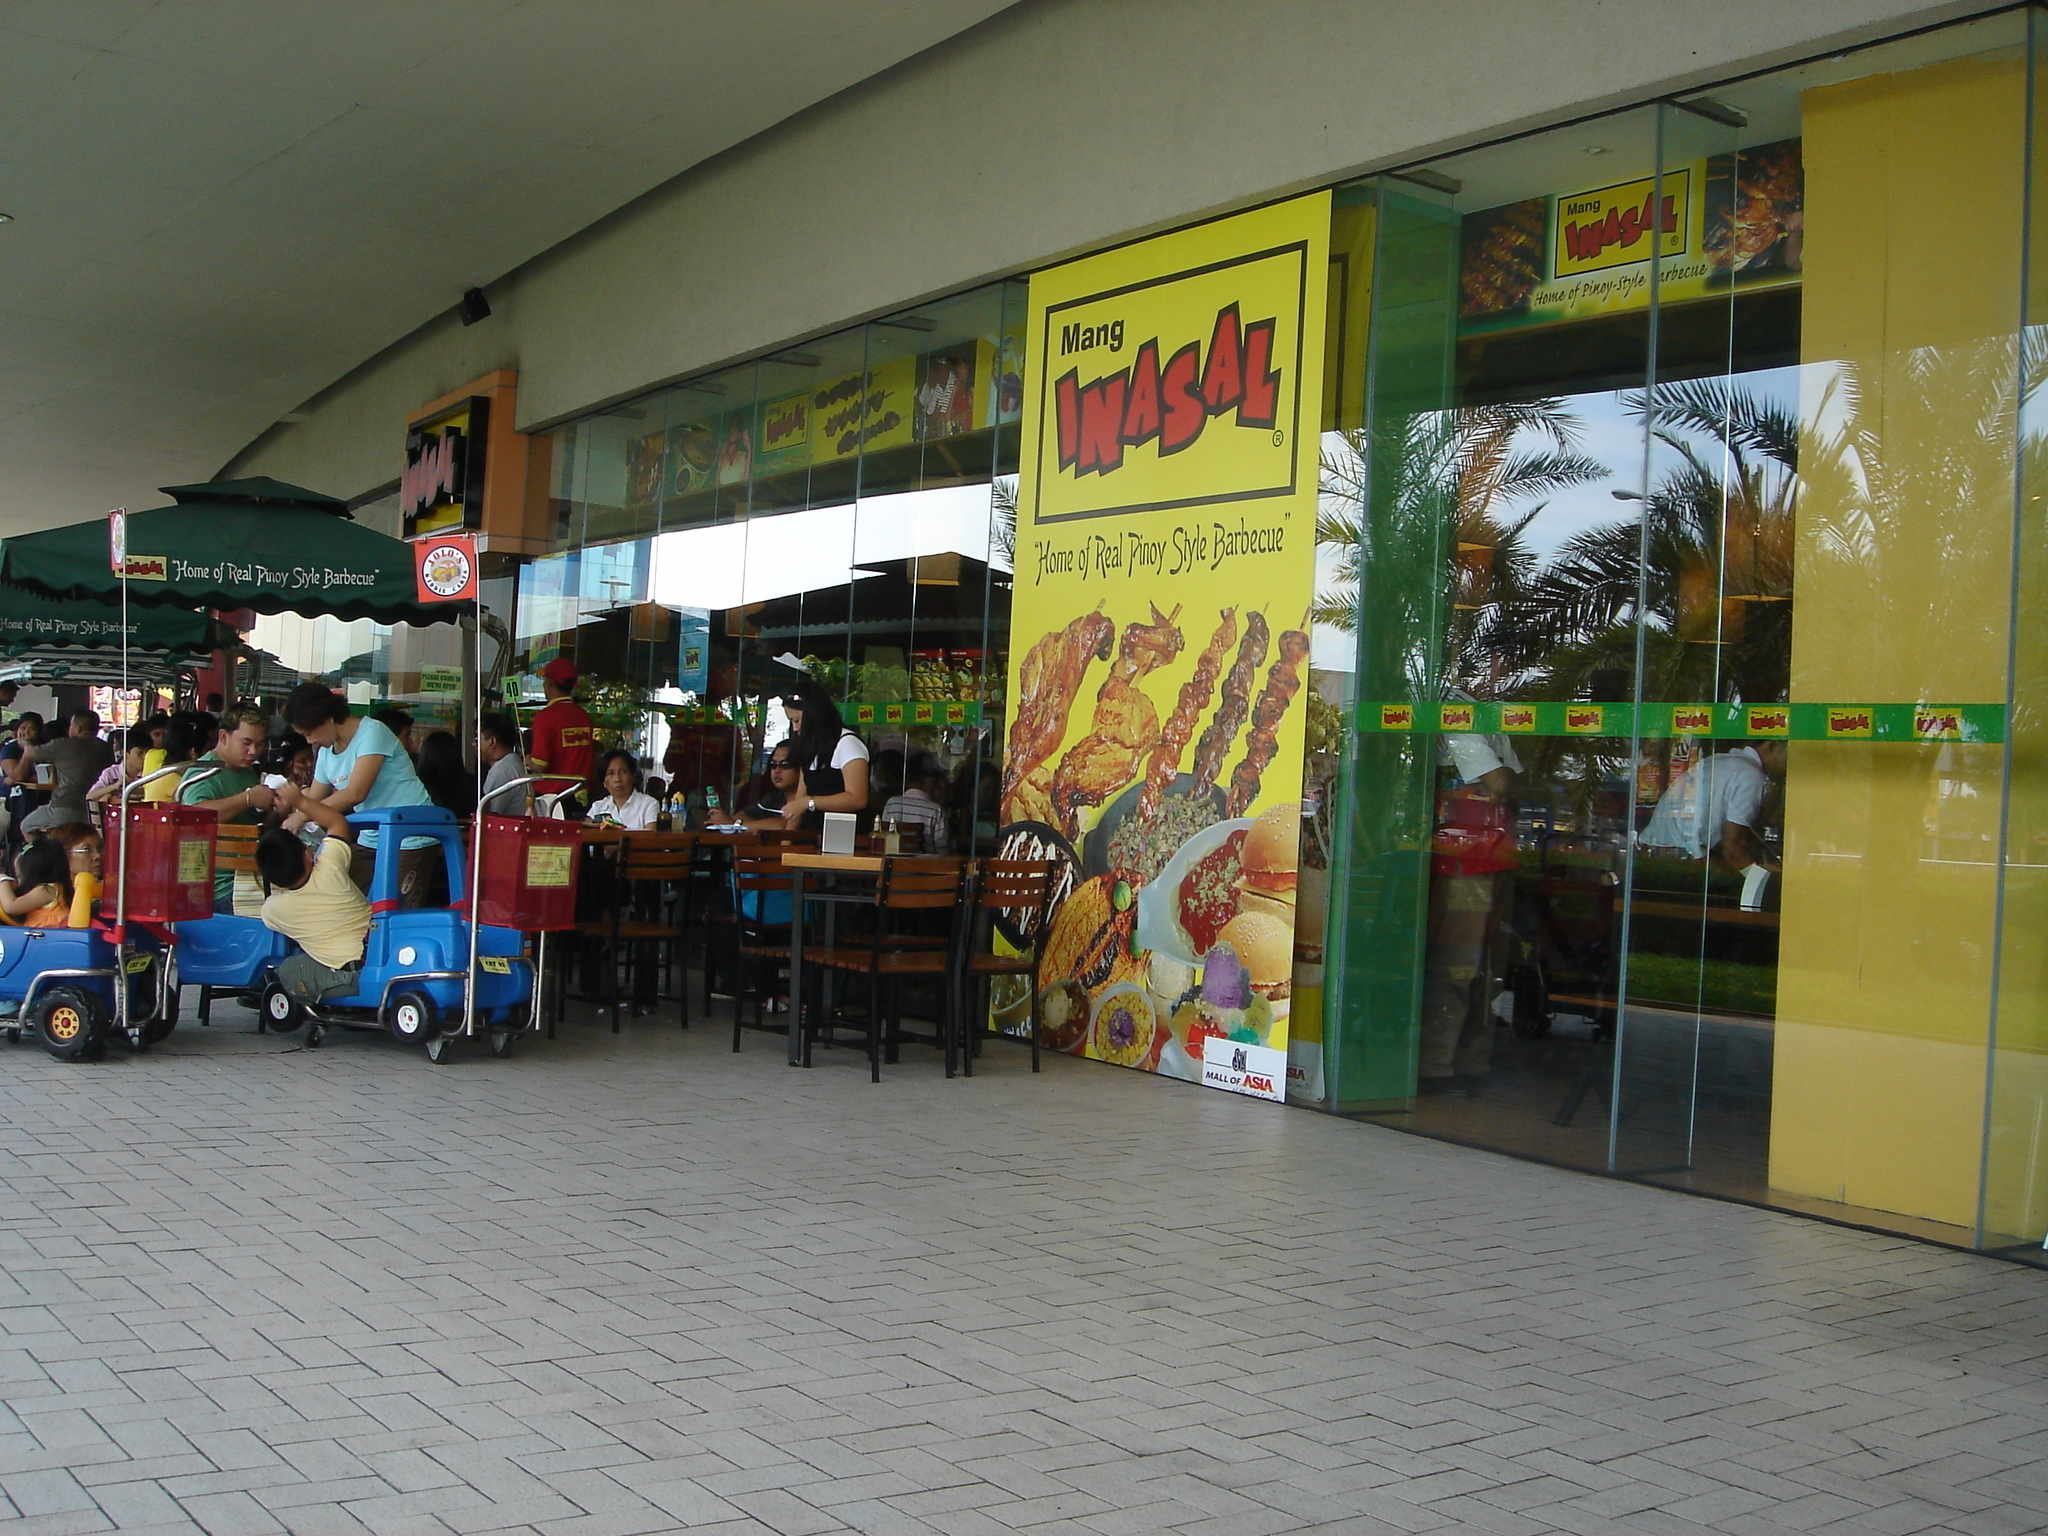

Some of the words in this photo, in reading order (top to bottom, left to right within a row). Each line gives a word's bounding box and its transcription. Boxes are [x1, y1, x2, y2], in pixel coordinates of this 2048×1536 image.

[1567, 200, 1601, 217] Mang
[1534, 289, 1567, 308] Home
[1568, 282, 1581, 310] of
[1655, 262, 1709, 284] arbecue
[1060, 317, 1125, 357] Mang
[1054, 299, 1283, 481] INASAL
[1078, 535, 1092, 581] of
[1094, 534, 1123, 579] Real
[1127, 531, 1167, 578] Pinoy
[1169, 524, 1208, 576] Style
[213, 561, 225, 584] of
[226, 562, 253, 585] Real
[255, 564, 289, 587] Pinoy
[291, 566, 320, 589] Style
[506, 681, 519, 698] 40
[1206, 1071, 1229, 1083] MALL
[1229, 1076, 1240, 1086] OF
[1243, 1074, 1274, 1093] ASIA
